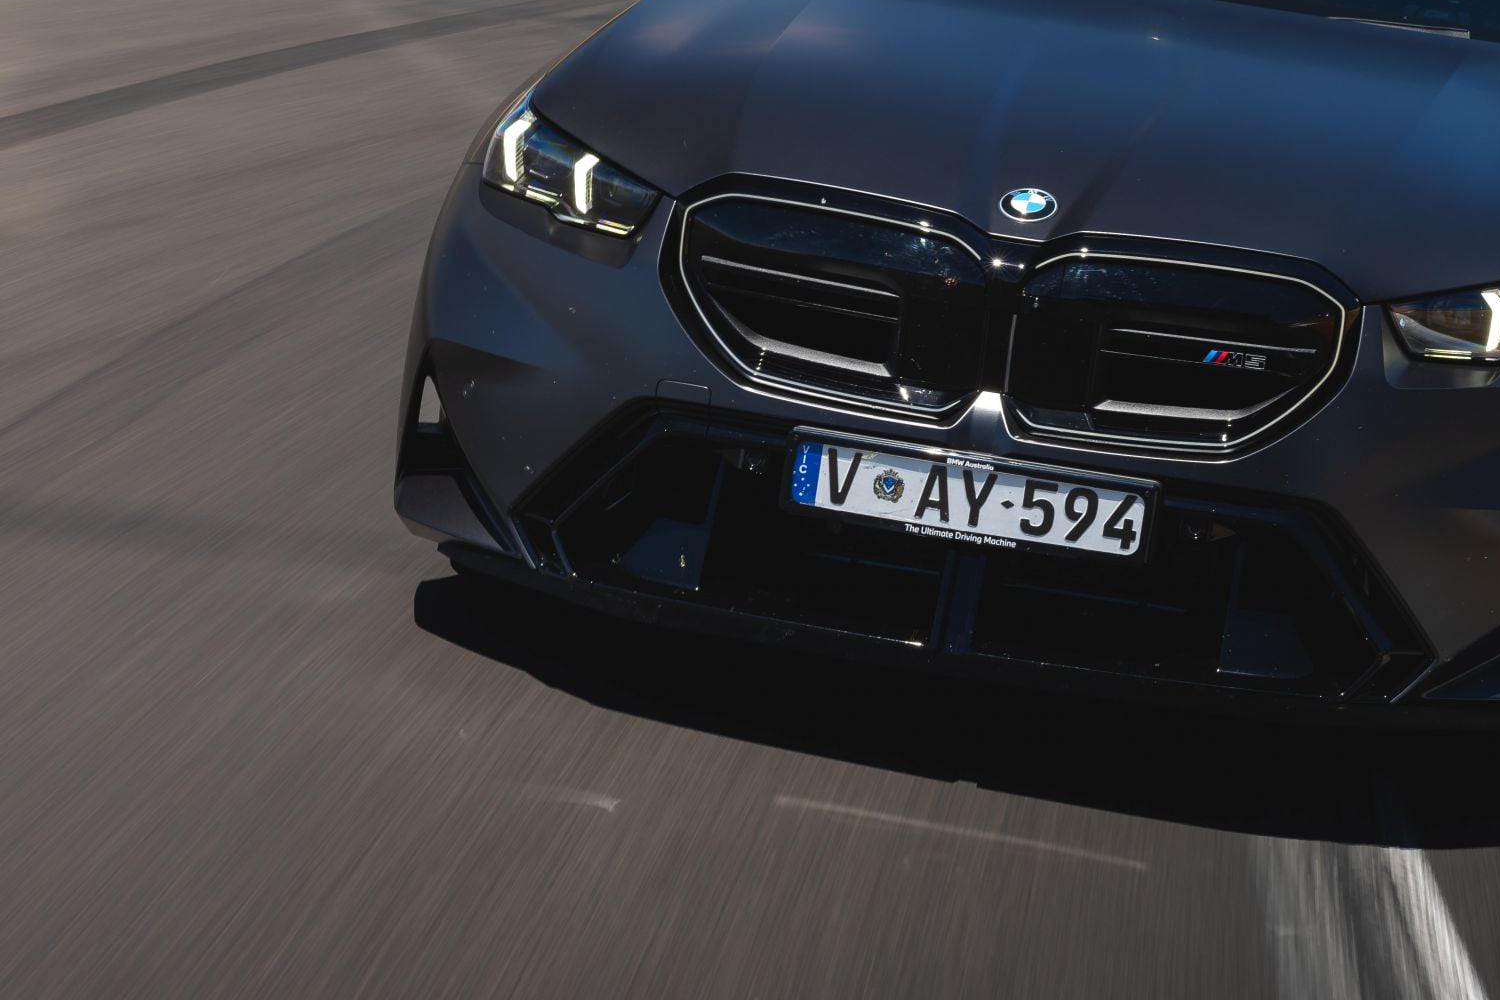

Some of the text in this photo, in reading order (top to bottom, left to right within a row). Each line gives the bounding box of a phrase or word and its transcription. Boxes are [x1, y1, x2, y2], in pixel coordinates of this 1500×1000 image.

[1221, 351, 1267, 370] M5
[798, 444, 811, 474] VIC
[946, 457, 995, 471] BMW Australia
[904, 523, 1018, 549] The Ultimate Driving Machine
